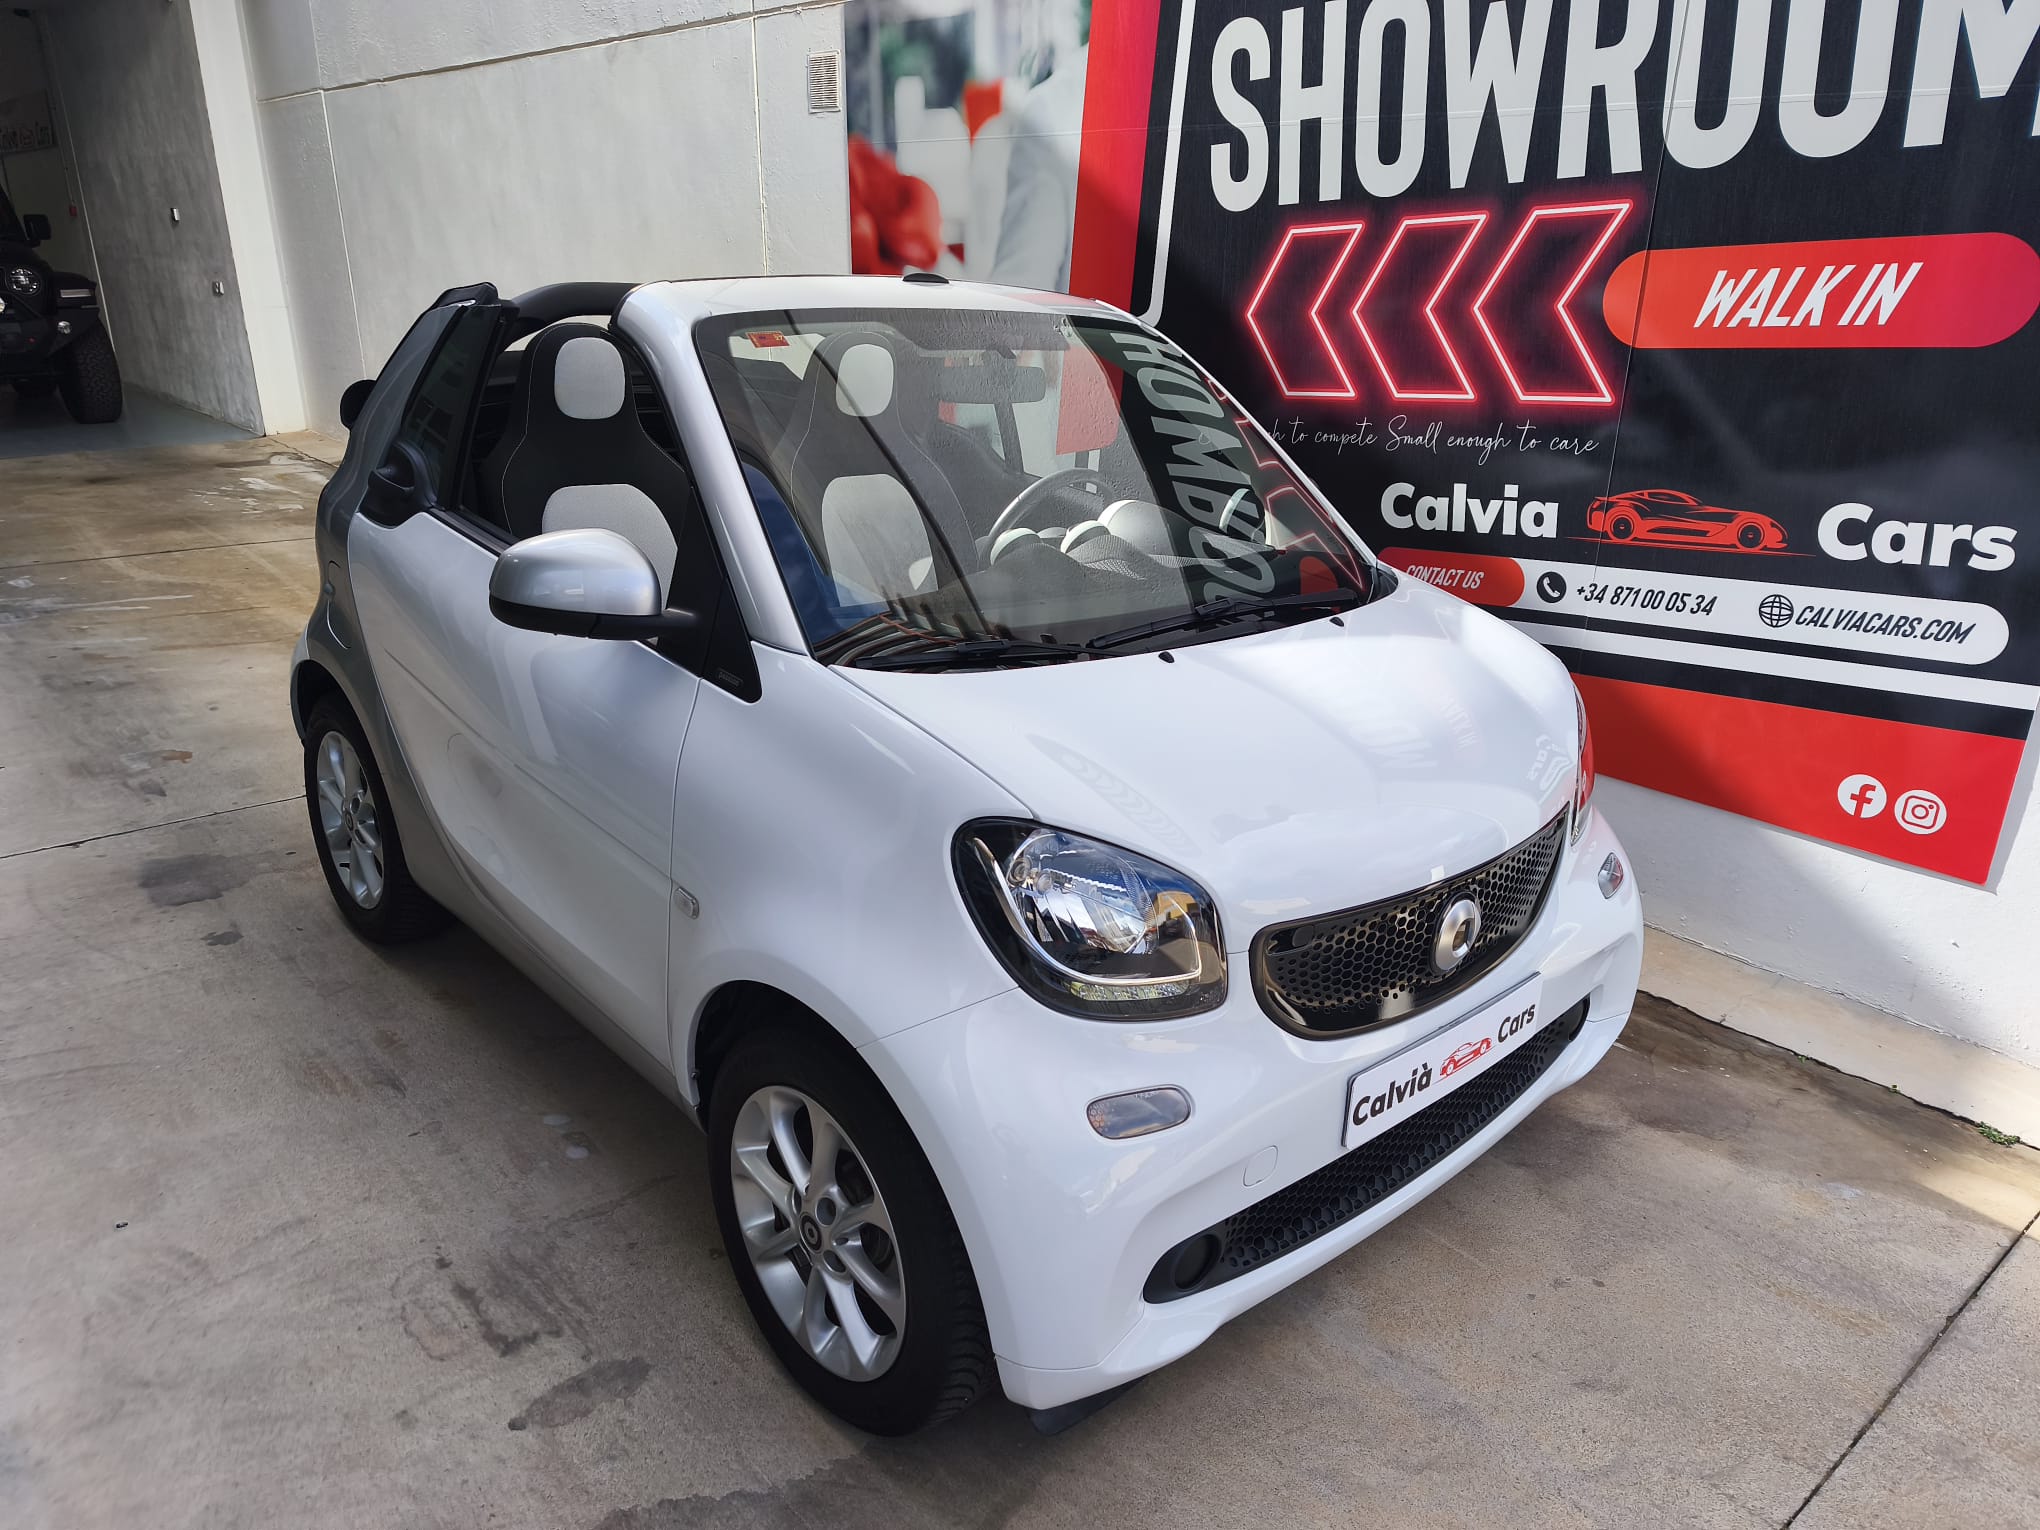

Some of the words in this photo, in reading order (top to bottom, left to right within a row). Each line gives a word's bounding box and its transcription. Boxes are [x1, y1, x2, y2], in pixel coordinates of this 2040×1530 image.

[1693, 264, 1857, 328] WALK
[1837, 262, 1924, 326] IN
[1314, 417, 1379, 455] compete
[1385, 414, 1443, 455] Small
[1447, 422, 1514, 466] enough
[1516, 418, 1543, 451] to
[1549, 434, 1601, 456] care
[1380, 482, 1560, 539] Calvia
[1817, 502, 2018, 572] Cars
[1407, 564, 1465, 587] CONTACT
[1462, 570, 1485, 589] US
[1577, 582, 1609, 604] +34
[1610, 585, 1642, 608] 871
[1640, 589, 1666, 610] 00
[1665, 591, 1692, 613] 05
[1690, 594, 1718, 616] 34
[1795, 605, 1977, 645] CALVIACARS.COM
[1352, 1062, 1433, 1127] Calvià
[1497, 1003, 1536, 1043] Cars
